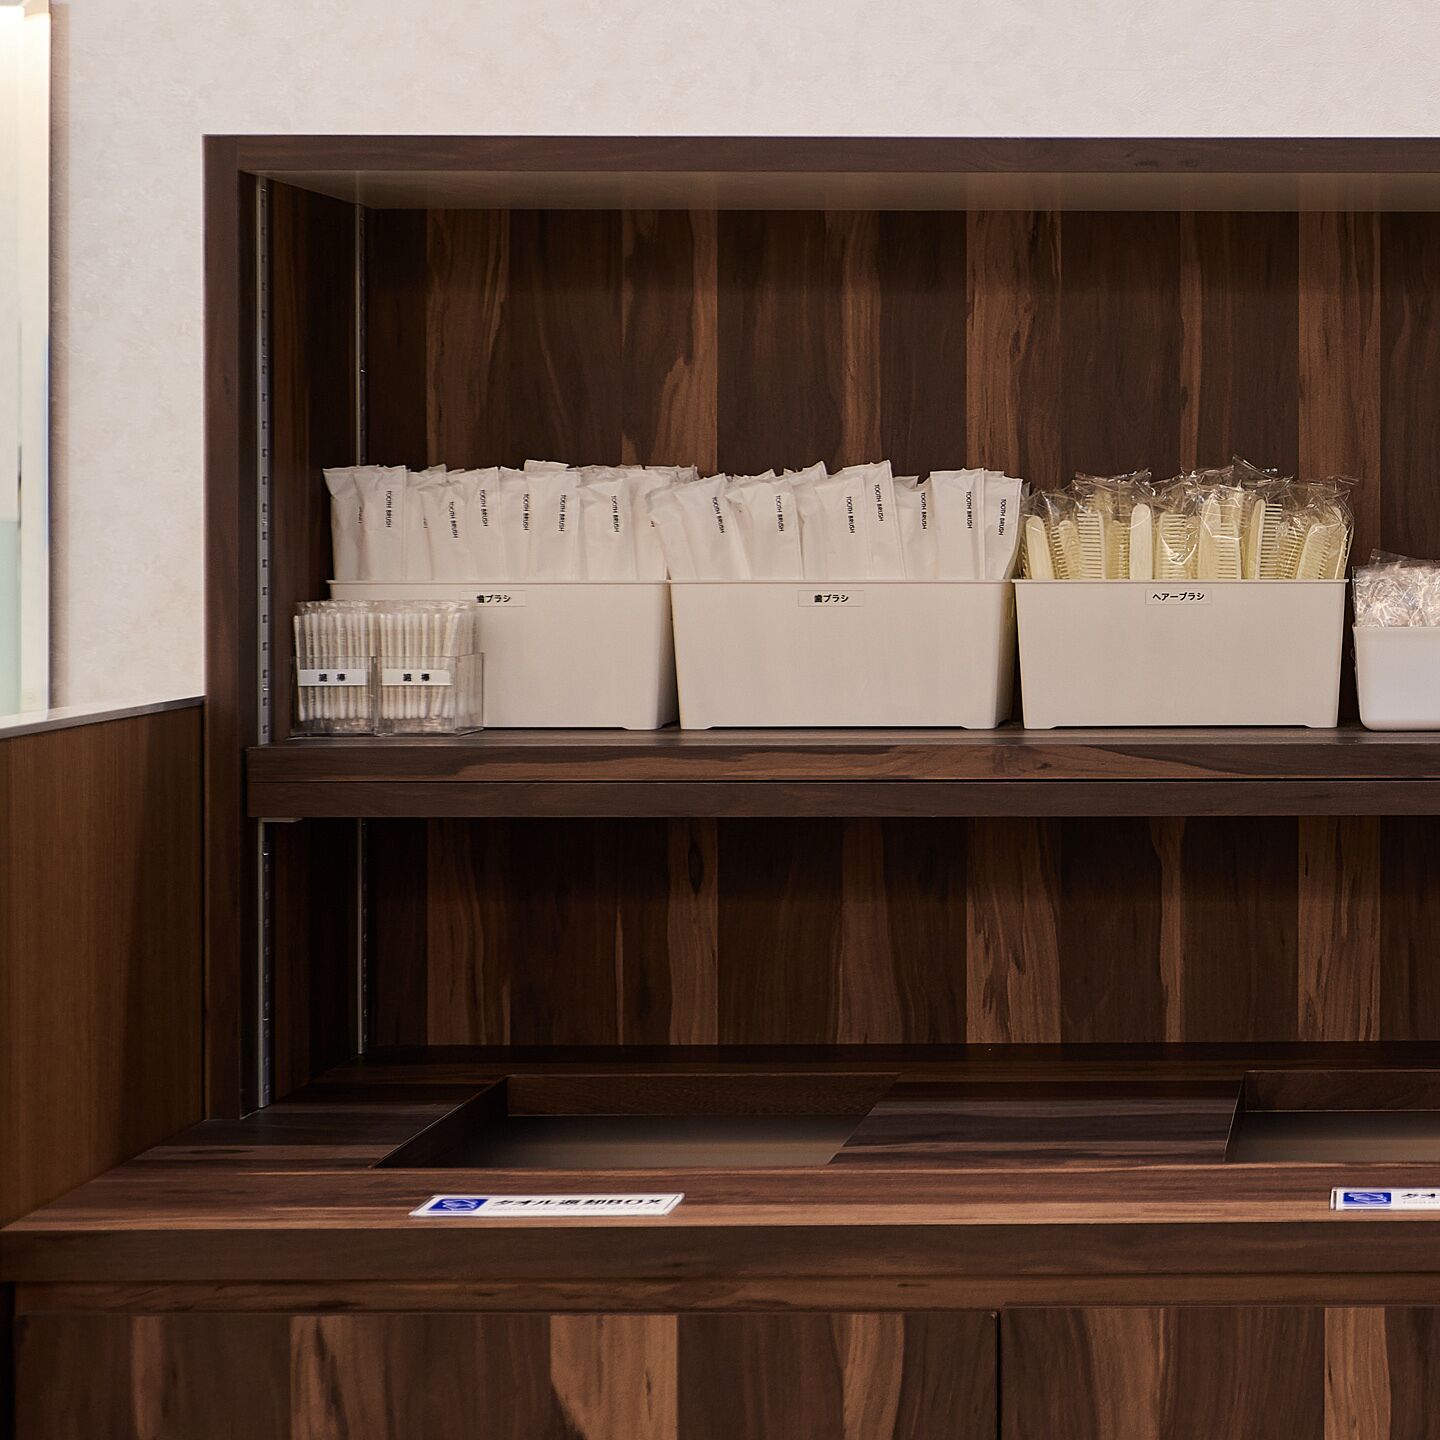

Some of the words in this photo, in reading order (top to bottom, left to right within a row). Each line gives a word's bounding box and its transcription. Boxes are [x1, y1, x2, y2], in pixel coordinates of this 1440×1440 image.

[385, 491, 393, 509] TOOTH
[479, 490, 487, 508] TOOTH
[874, 485, 882, 503] TOOTH
[448, 502, 456, 519] TOOTH
[559, 495, 567, 513] TOOTH
[775, 496, 783, 513] TOOTH
[846, 497, 854, 515] TOOTH
[876, 504, 884, 522] BRUSH
[480, 509, 489, 527] BRUSH
[522, 513, 530, 531] BRUSH
[558, 514, 566, 532] BRUSH
[612, 515, 620, 533] BRUSH
[711, 497, 721, 515] TOOTH
[716, 516, 725, 534] BRUSH
[777, 514, 785, 532] BRUSH
[450, 521, 458, 539] BRUSH
[847, 516, 855, 534] BRUSH
[998, 518, 1006, 536] BRUSH
[814, 593, 849, 603] 歯ブラシ
[1152, 591, 1205, 601] ヘアーブラシ
